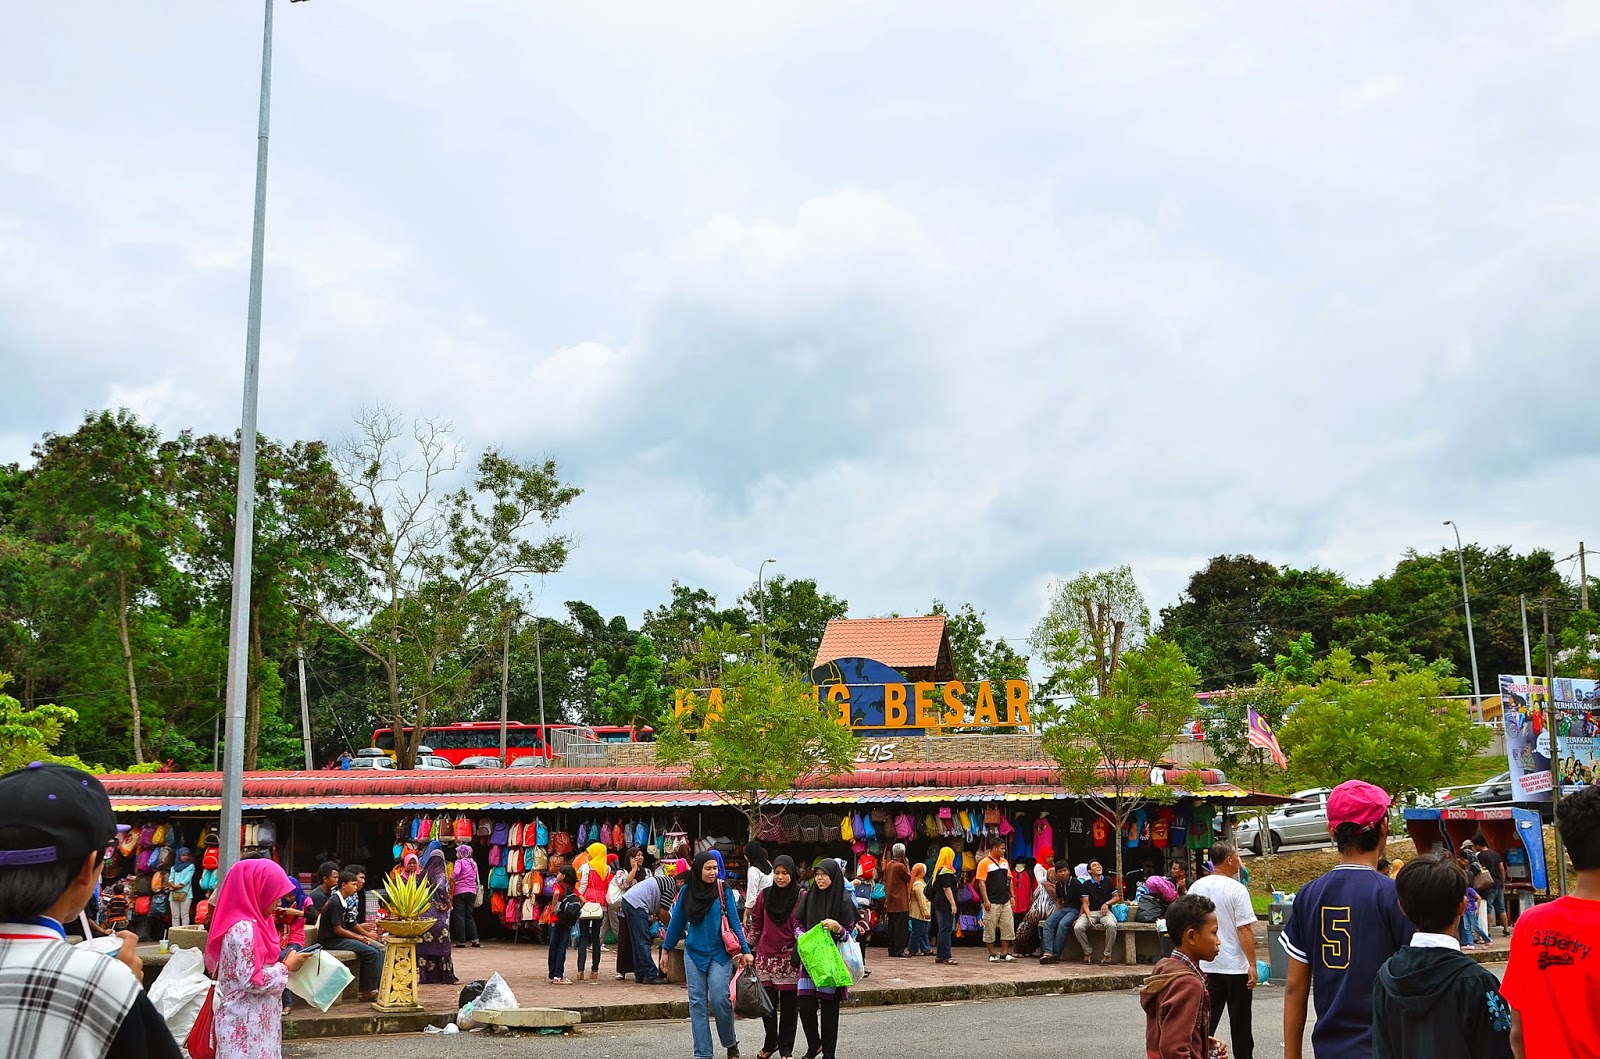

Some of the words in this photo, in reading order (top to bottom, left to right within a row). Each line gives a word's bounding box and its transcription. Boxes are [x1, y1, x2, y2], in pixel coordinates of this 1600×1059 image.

[885, 680, 1031, 727] BESAR
[1448, 808, 1468, 819] helo
[1483, 809, 1504, 819] helo
[1092, 821, 1105, 840] 6
[1321, 906, 1351, 969] 5
